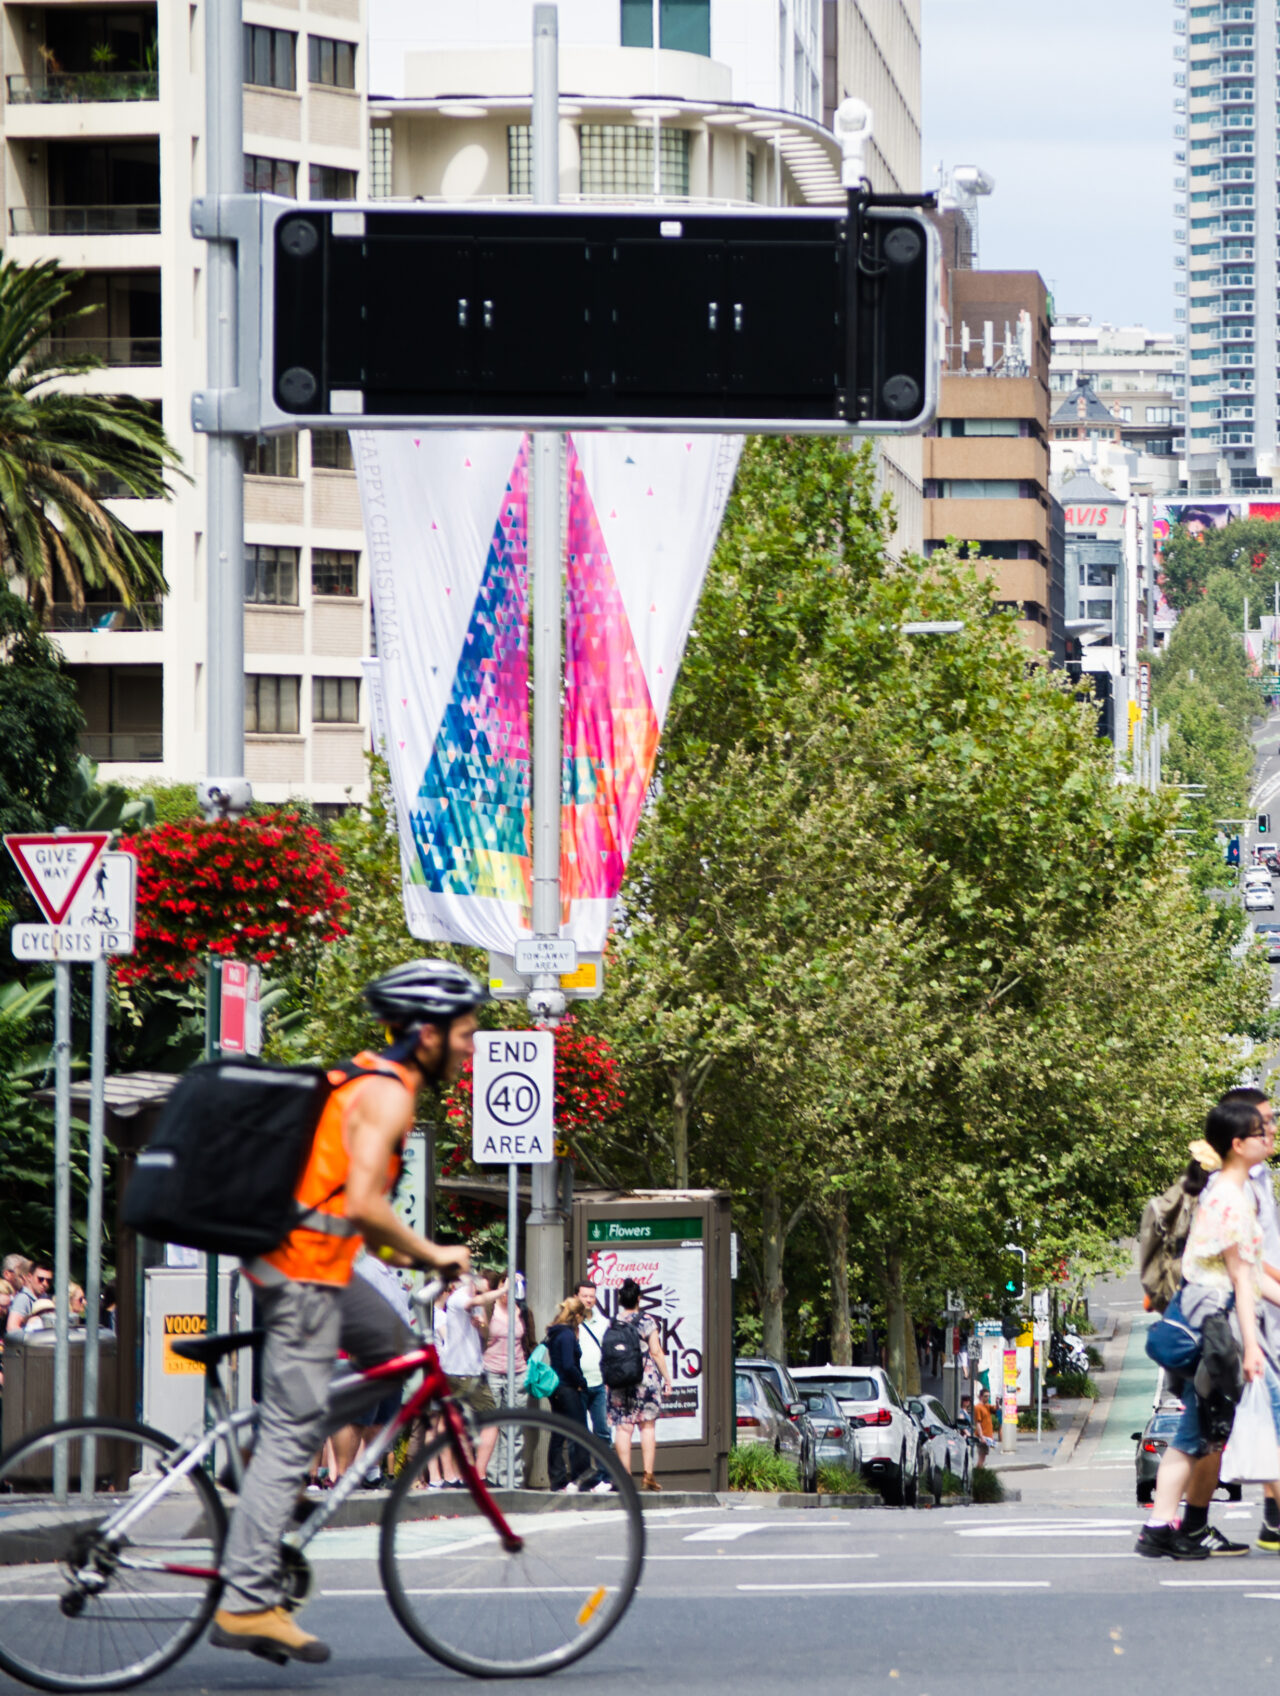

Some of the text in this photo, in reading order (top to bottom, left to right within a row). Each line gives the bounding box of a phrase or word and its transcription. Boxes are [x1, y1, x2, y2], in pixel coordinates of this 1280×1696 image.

[1064, 507, 1109, 526] AVIS
[370, 514, 400, 661] CHRISTMAS
[35, 848, 78, 864] GIVE
[43, 867, 69, 879] WAY
[21, 932, 92, 952] CYCLISTS
[488, 1041, 538, 1062] END
[492, 1086, 534, 1112] 40
[483, 1135, 543, 1154] AREA
[608, 1223, 652, 1237] Flowers
[604, 1252, 659, 1276] Famous
